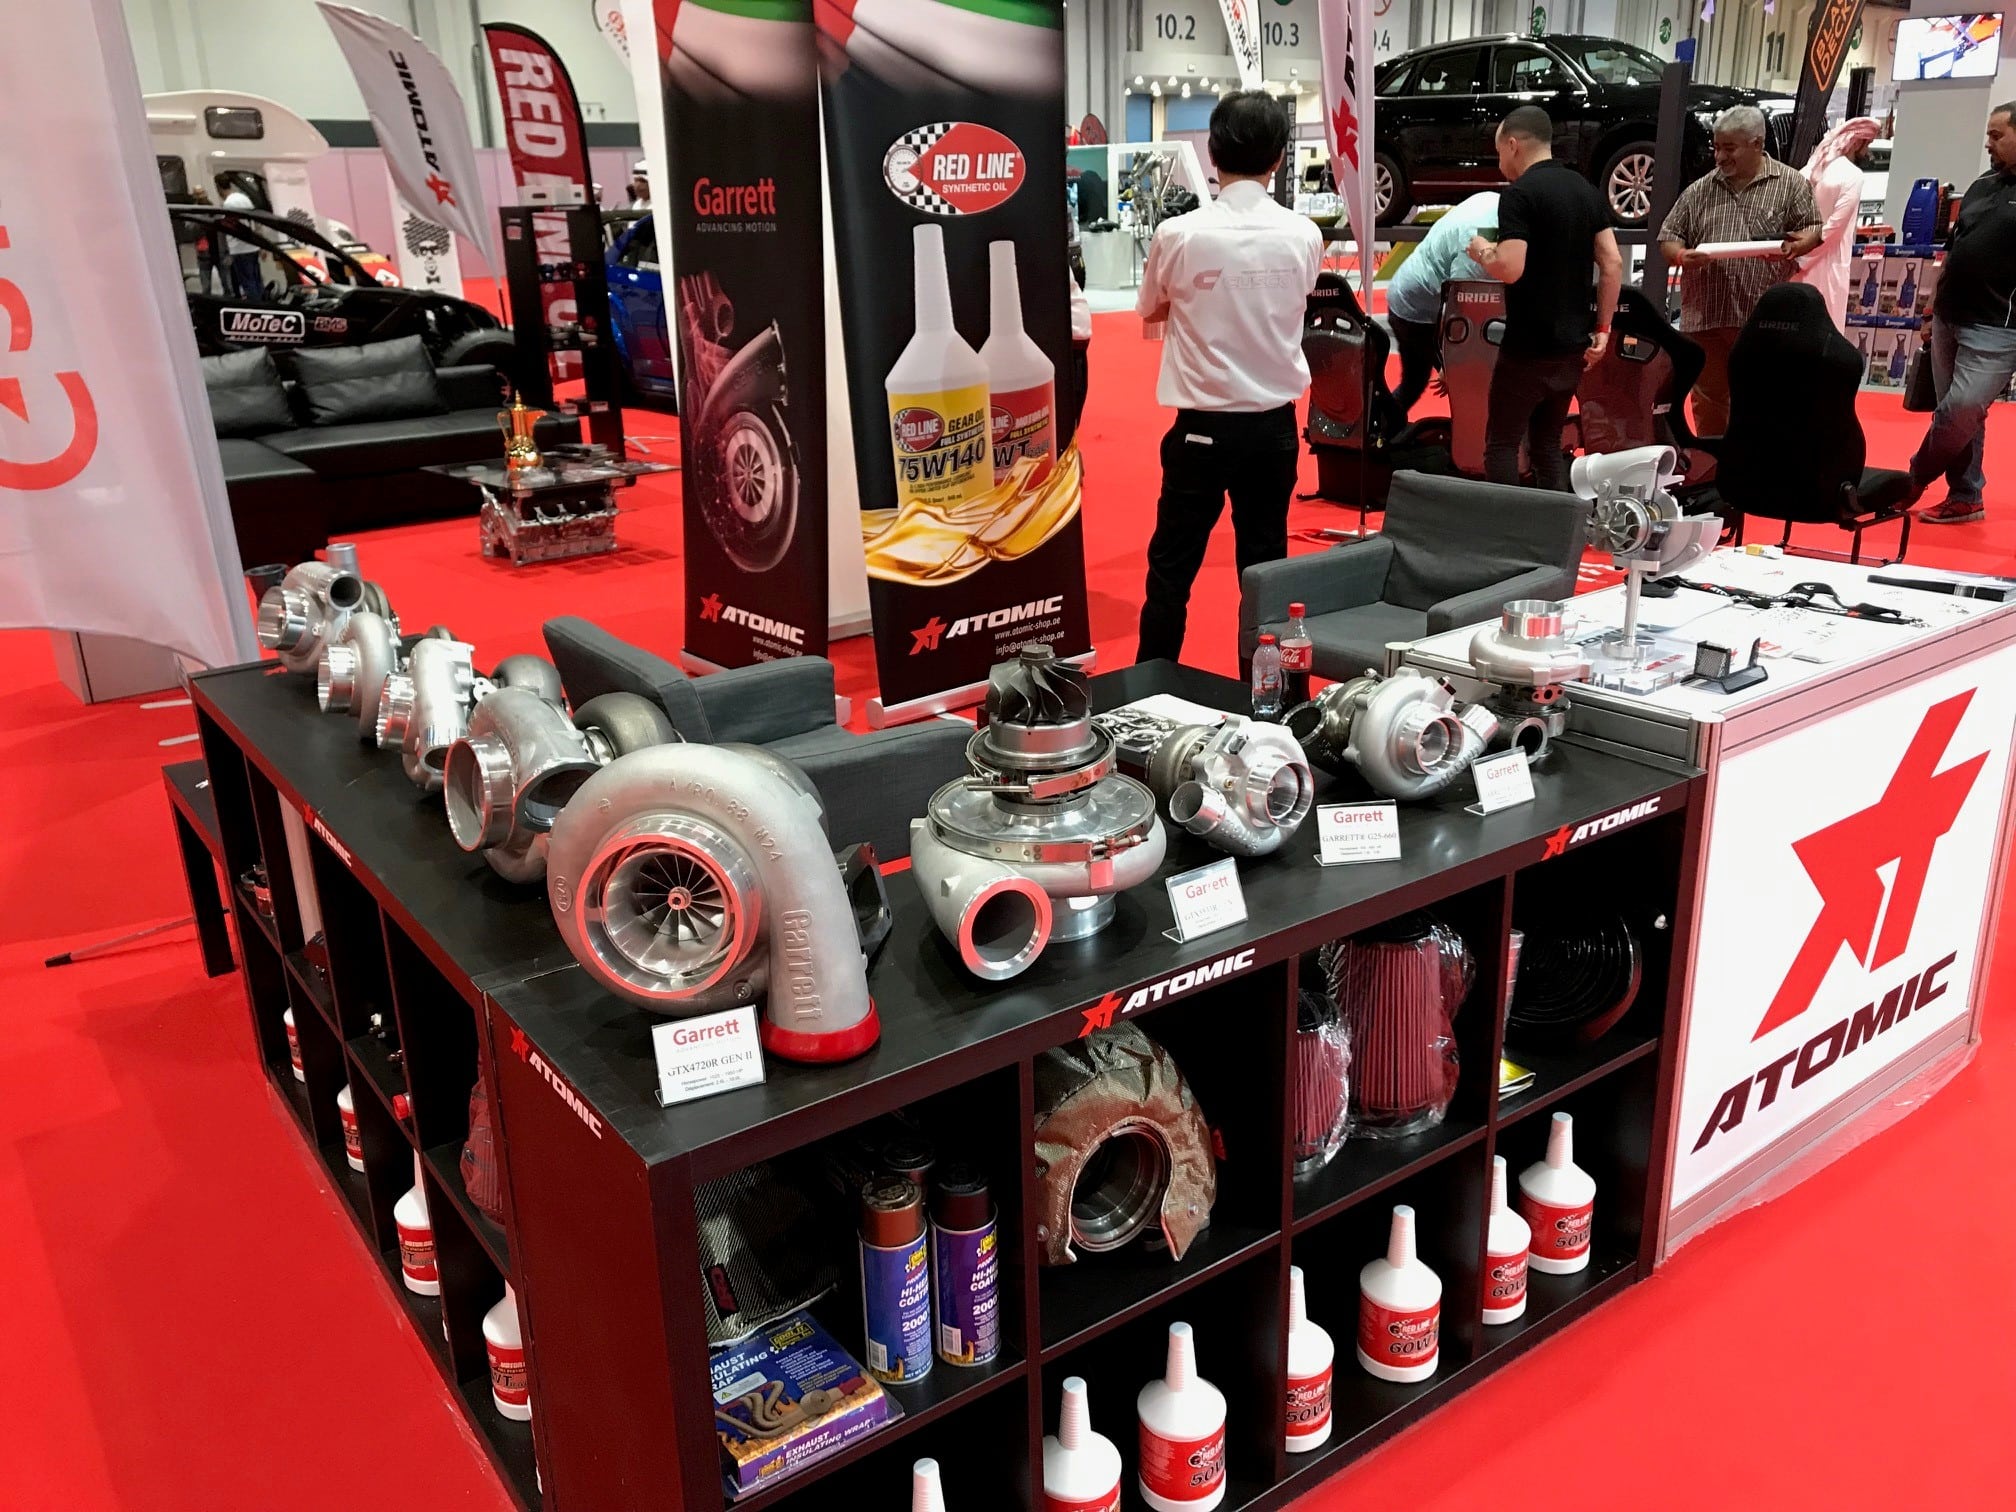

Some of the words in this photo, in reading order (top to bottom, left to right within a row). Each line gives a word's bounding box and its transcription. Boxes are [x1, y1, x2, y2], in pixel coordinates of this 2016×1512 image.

[1155, 13, 1196, 41] 10.2
[1264, 21, 1300, 47] 10.3
[1816, 0, 1843, 61] BLA
[1821, 0, 1853, 76] DECK
[1766, 31, 1786, 73] 11
[388, 49, 441, 172] ATOMIC
[498, 48, 567, 158] RED
[932, 153, 970, 181] RED
[975, 151, 1016, 180] LINE
[693, 176, 776, 216] Garrett
[942, 182, 991, 194] SYNTHETIC
[992, 181, 1008, 192] OIL
[696, 221, 743, 233] ADVANCING
[744, 221, 777, 233] MOTION
[1457, 291, 1501, 304] BRIDE
[230, 312, 298, 333] MoTeC
[1759, 319, 1800, 332] BRIDE
[902, 422, 917, 438] RED
[917, 417, 939, 436] LINE
[948, 413, 974, 433] GEAR
[940, 435, 956, 447] FULL
[898, 436, 986, 483] 75W140
[721, 605, 806, 646] ATOMIC
[945, 594, 1064, 639] ATOMIC
[994, 616, 1061, 641] www.atomic-shop.ae
[1486, 761, 1520, 780] Garrett
[1333, 809, 1384, 824] Garrett
[1569, 796, 1661, 845] ATOMIC
[313, 817, 352, 868] ATOMIC
[781, 907, 826, 1022] Garrett
[1121, 947, 1256, 1014] ATOMIC
[672, 1018, 740, 1047] Garrett
[667, 1058, 719, 1077] GTX4720R
[720, 1053, 743, 1066] GEN
[743, 1050, 753, 1060] II
[1690, 949, 1958, 1156] ATOMIC
[528, 1051, 602, 1140] ATOMIC
[972, 1295, 998, 1317] 2000
[902, 1312, 928, 1333] 2000
[1402, 1324, 1417, 1334] RED
[1417, 1318, 1431, 1330] LINE
[710, 1352, 746, 1375] AUST
[1298, 1391, 1313, 1401] RED
[1313, 1382, 1326, 1396] LINE
[785, 1434, 842, 1465] INSULATING
[844, 1418, 872, 1438] WRAP
[785, 1431, 831, 1460] EXHAUST
